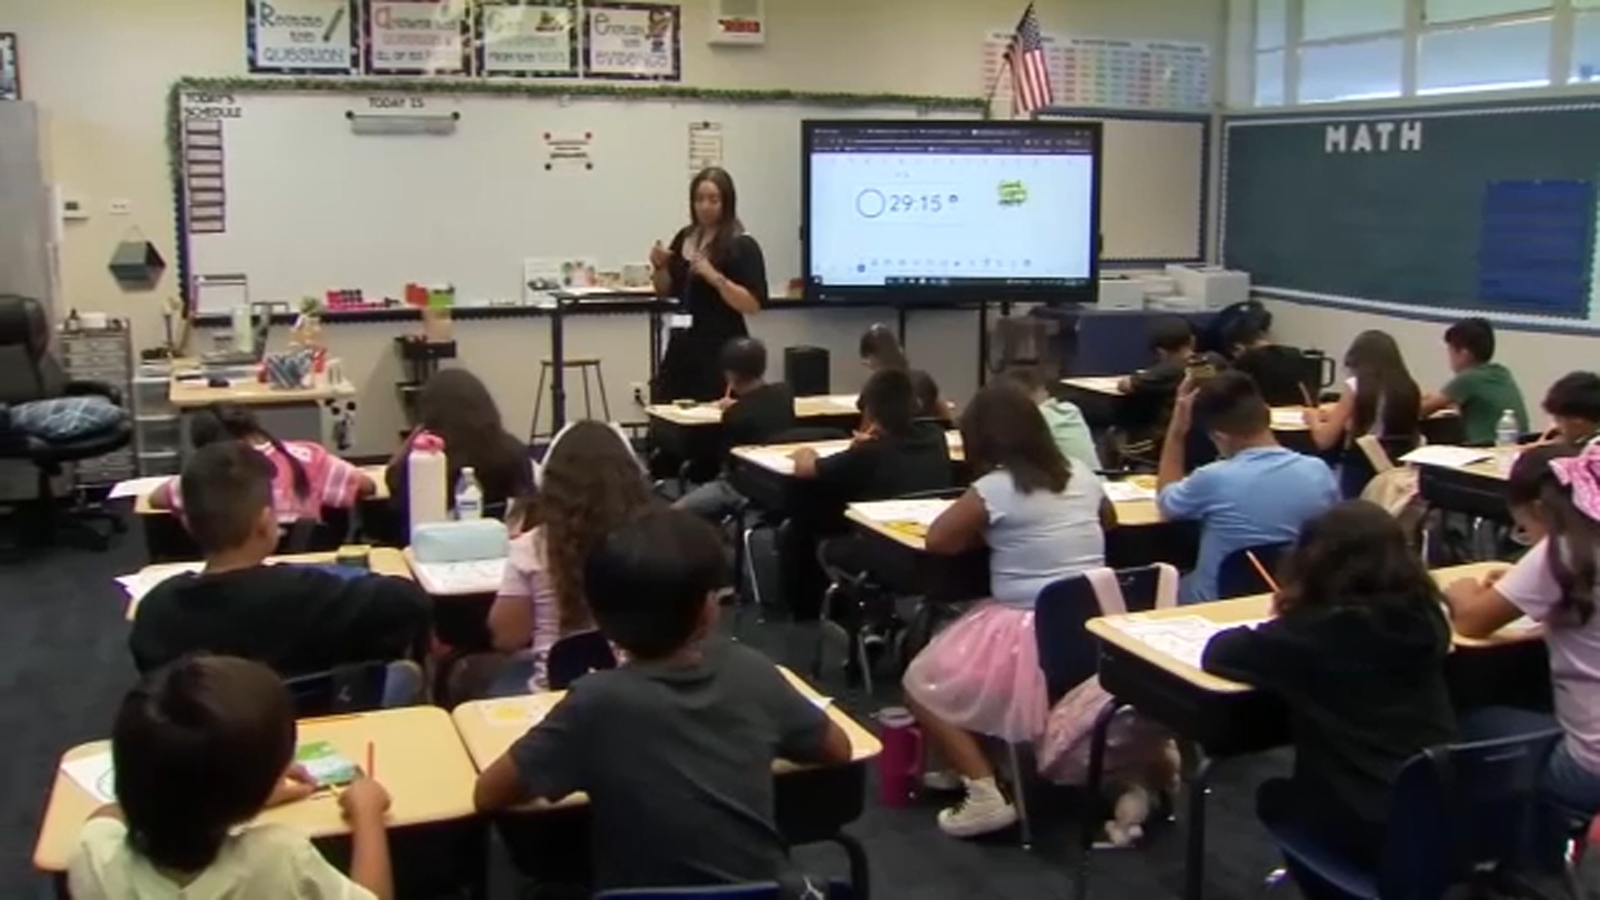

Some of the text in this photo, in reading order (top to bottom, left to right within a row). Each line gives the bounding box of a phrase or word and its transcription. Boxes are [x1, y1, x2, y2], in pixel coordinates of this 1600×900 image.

[369, 96, 425, 109] TODAY IS
[184, 106, 242, 119] SCHEDULE
[1325, 121, 1422, 152] MATH
[889, 193, 943, 213] 29:15
